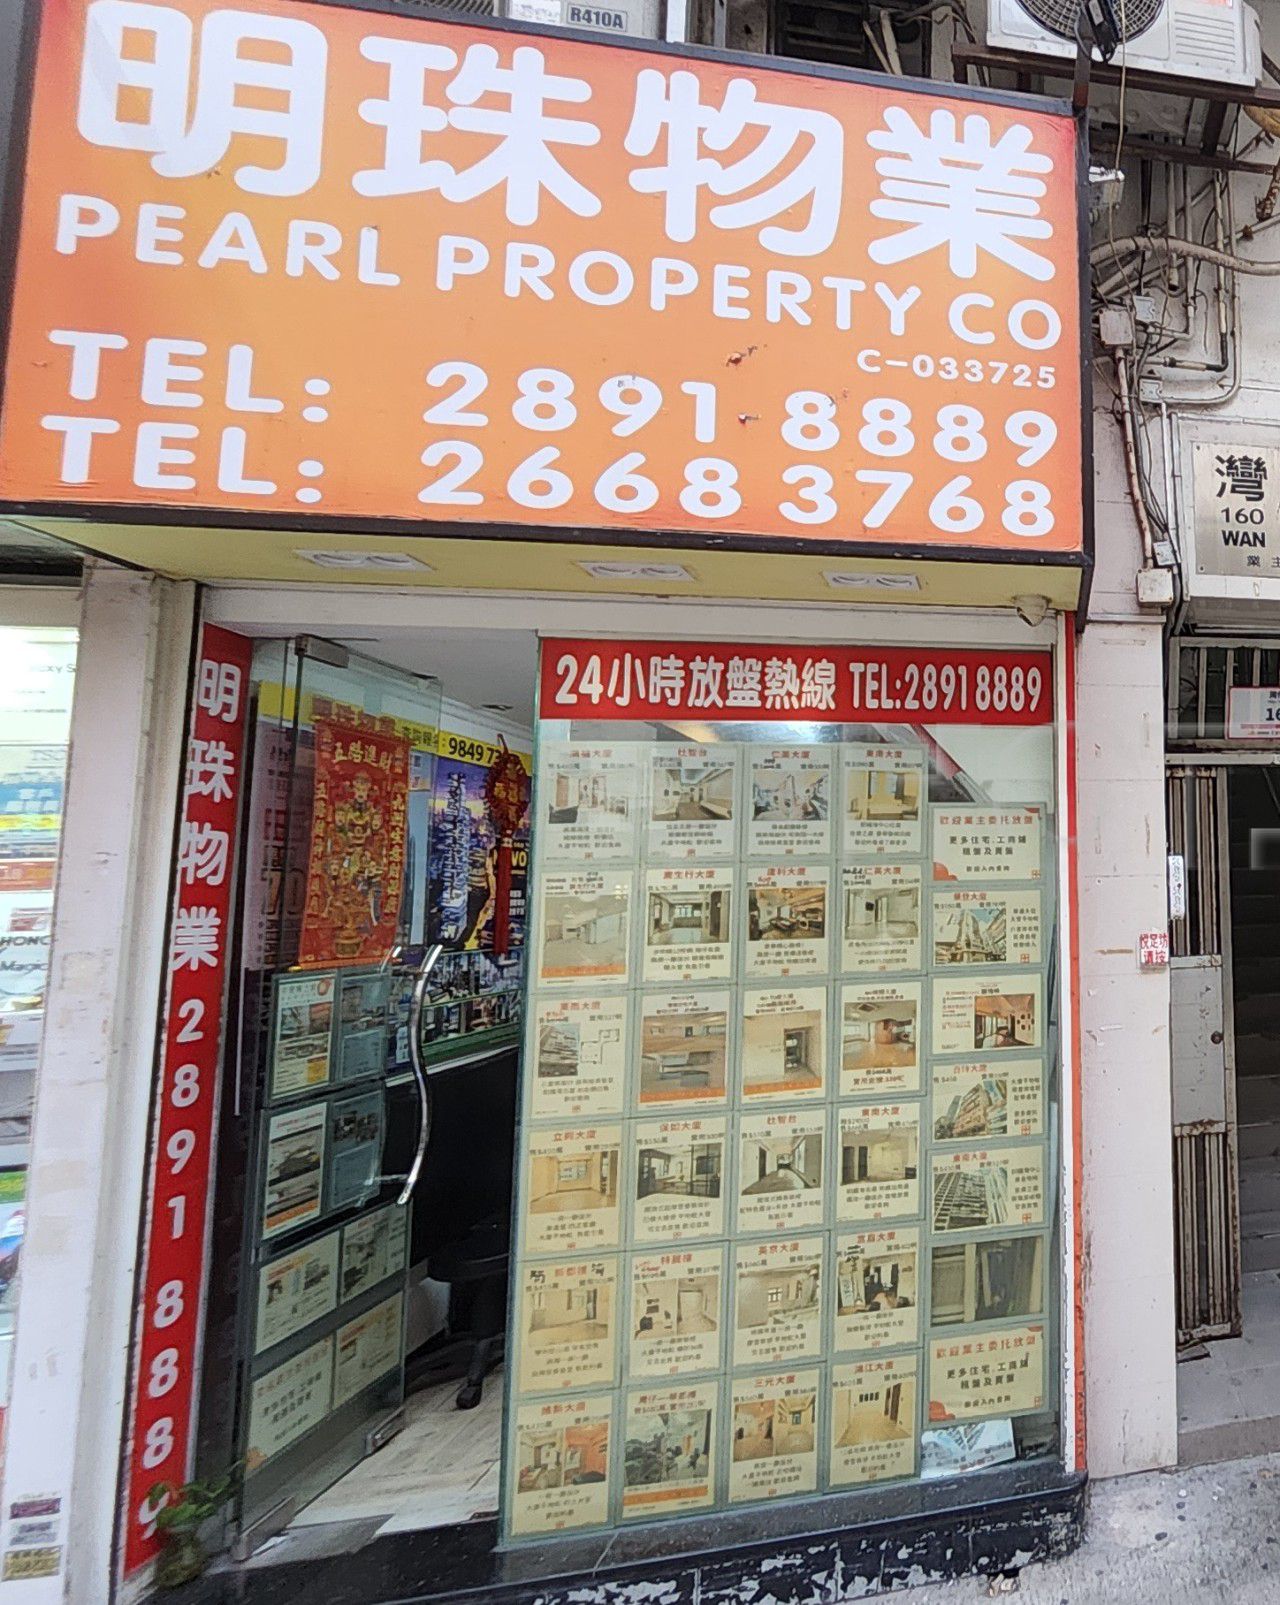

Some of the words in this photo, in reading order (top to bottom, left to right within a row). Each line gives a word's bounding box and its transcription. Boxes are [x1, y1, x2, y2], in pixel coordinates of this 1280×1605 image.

[570, 6, 624, 28] R410A
[77, 0, 1056, 281] 明珠物業
[56, 193, 400, 286] PEARL
[435, 235, 922, 336] PROPERTY
[948, 292, 1062, 351] CO
[48, 329, 331, 424] TEL:
[423, 361, 717, 444] 2891
[780, 390, 1057, 467] 8889
[856, 349, 1056, 390] C-033725
[41, 415, 325, 504] TEL:
[417, 440, 741, 519] 2668
[778, 464, 1056, 537] 3768
[1220, 507, 1265, 525] 160
[1221, 530, 1267, 548] WAN
[555, 652, 838, 712] 24小時放盤熱線
[448, 736, 483, 763] 9849
[169, 659, 241, 972] 明珠物業
